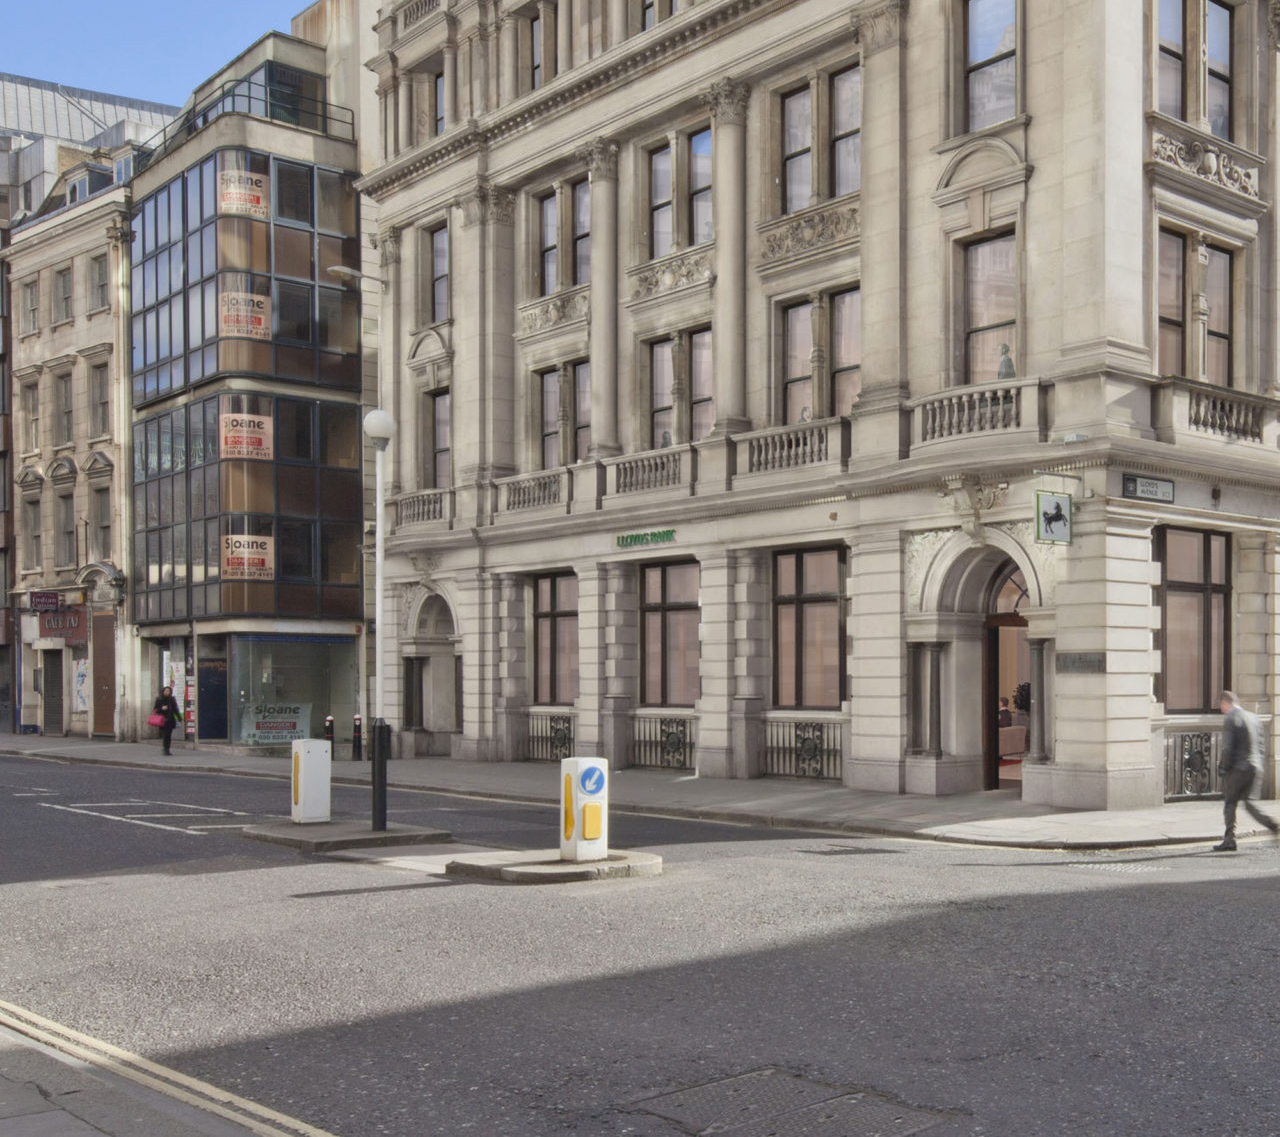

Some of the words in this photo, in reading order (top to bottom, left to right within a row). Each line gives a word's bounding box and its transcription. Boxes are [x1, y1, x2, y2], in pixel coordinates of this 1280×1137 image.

[220, 173, 262, 188] Sloane
[221, 295, 264, 311] Sloane
[224, 416, 264, 431] Sloane
[225, 537, 268, 553] Sloane
[616, 533, 650, 547] LLOYDS
[650, 529, 676, 544] BANK
[32, 596, 57, 604] Indian
[255, 704, 301, 719] Sloane
